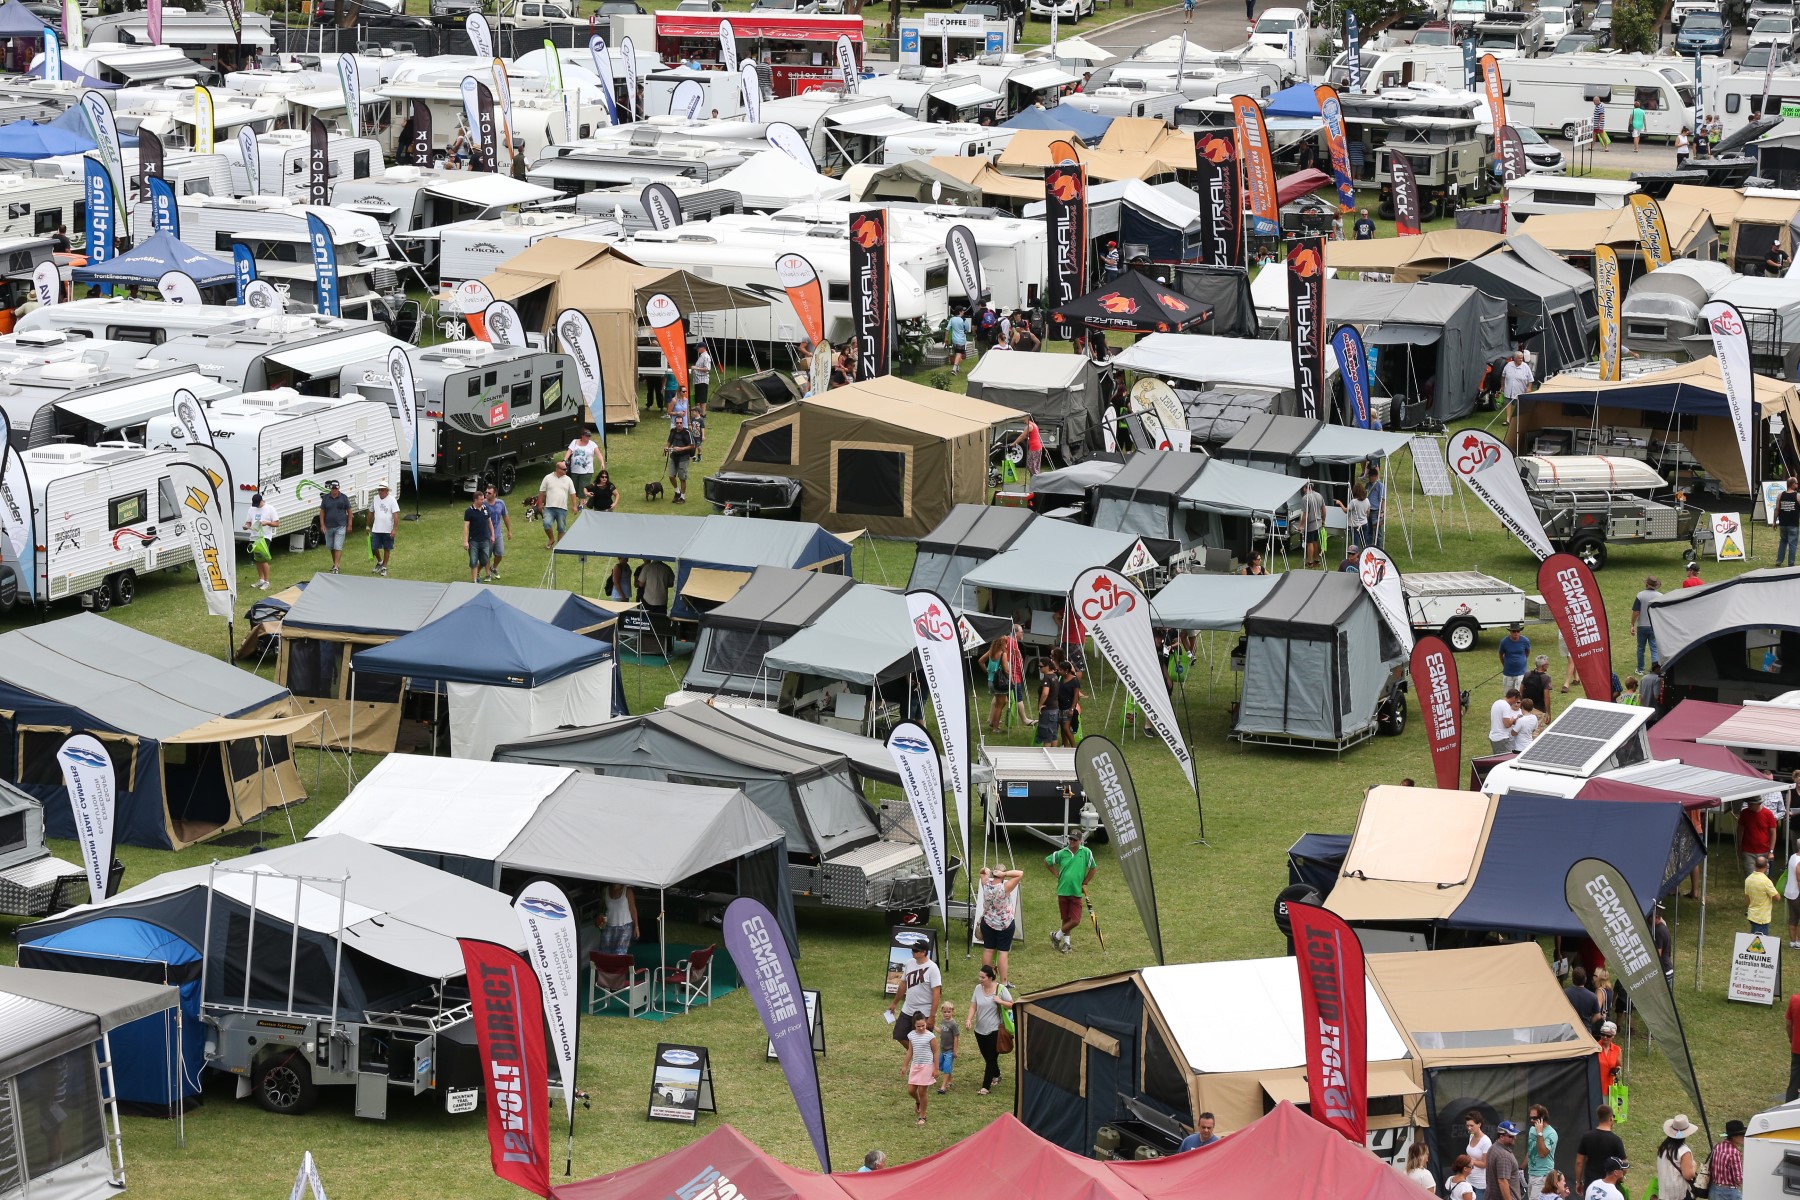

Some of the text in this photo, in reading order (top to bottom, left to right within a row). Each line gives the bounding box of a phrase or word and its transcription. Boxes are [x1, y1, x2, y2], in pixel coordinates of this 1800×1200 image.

[342, 56, 359, 118] Regent
[1348, 35, 1360, 90] WIFT
[86, 95, 120, 164] Regent
[1209, 166, 1228, 268] ZYTRAIL
[1636, 206, 1649, 240] CAMPERS
[1641, 202, 1661, 260] Blue Tongue
[125, 256, 165, 264] frontline
[1057, 205, 1072, 339] EYTRAIL
[1598, 256, 1616, 320] Blue Tongue
[861, 252, 876, 381] ZYTRAIL
[1084, 316, 1138, 327] EZYTRAIL
[1343, 333, 1366, 421] AUSSIE SWAG CAMPERS
[492, 415, 505, 423] MODEL
[511, 413, 540, 429] Crusader
[368, 449, 397, 466] Crusader
[2, 481, 23, 525] usader
[1469, 476, 1549, 560] www.cubcampers.co
[1567, 567, 1600, 642] COMPLETE
[1578, 650, 1591, 658] Hard
[1092, 624, 1189, 762] www.cubcampers.com.au
[1434, 652, 1456, 737] COMPLETE
[1436, 745, 1449, 753] Hard
[1100, 752, 1137, 839] COMPLETE
[1595, 874, 1652, 965] COMPLETE
[752, 915, 798, 1016] COMPLETE
[1305, 925, 1339, 1021] DIRECT
[1615, 946, 1632, 977] FURTHER
[1630, 969, 1659, 991] Hard Floor
[1735, 959, 1760, 968] Australian
[1739, 953, 1772, 963] GENUINE
[480, 962, 518, 1061] DIRECT
[764, 991, 777, 1024] FURTHER
[1736, 990, 1765, 998] Compliance
[1743, 984, 1771, 993] Engineering
[775, 1029, 787, 1039] Soft
